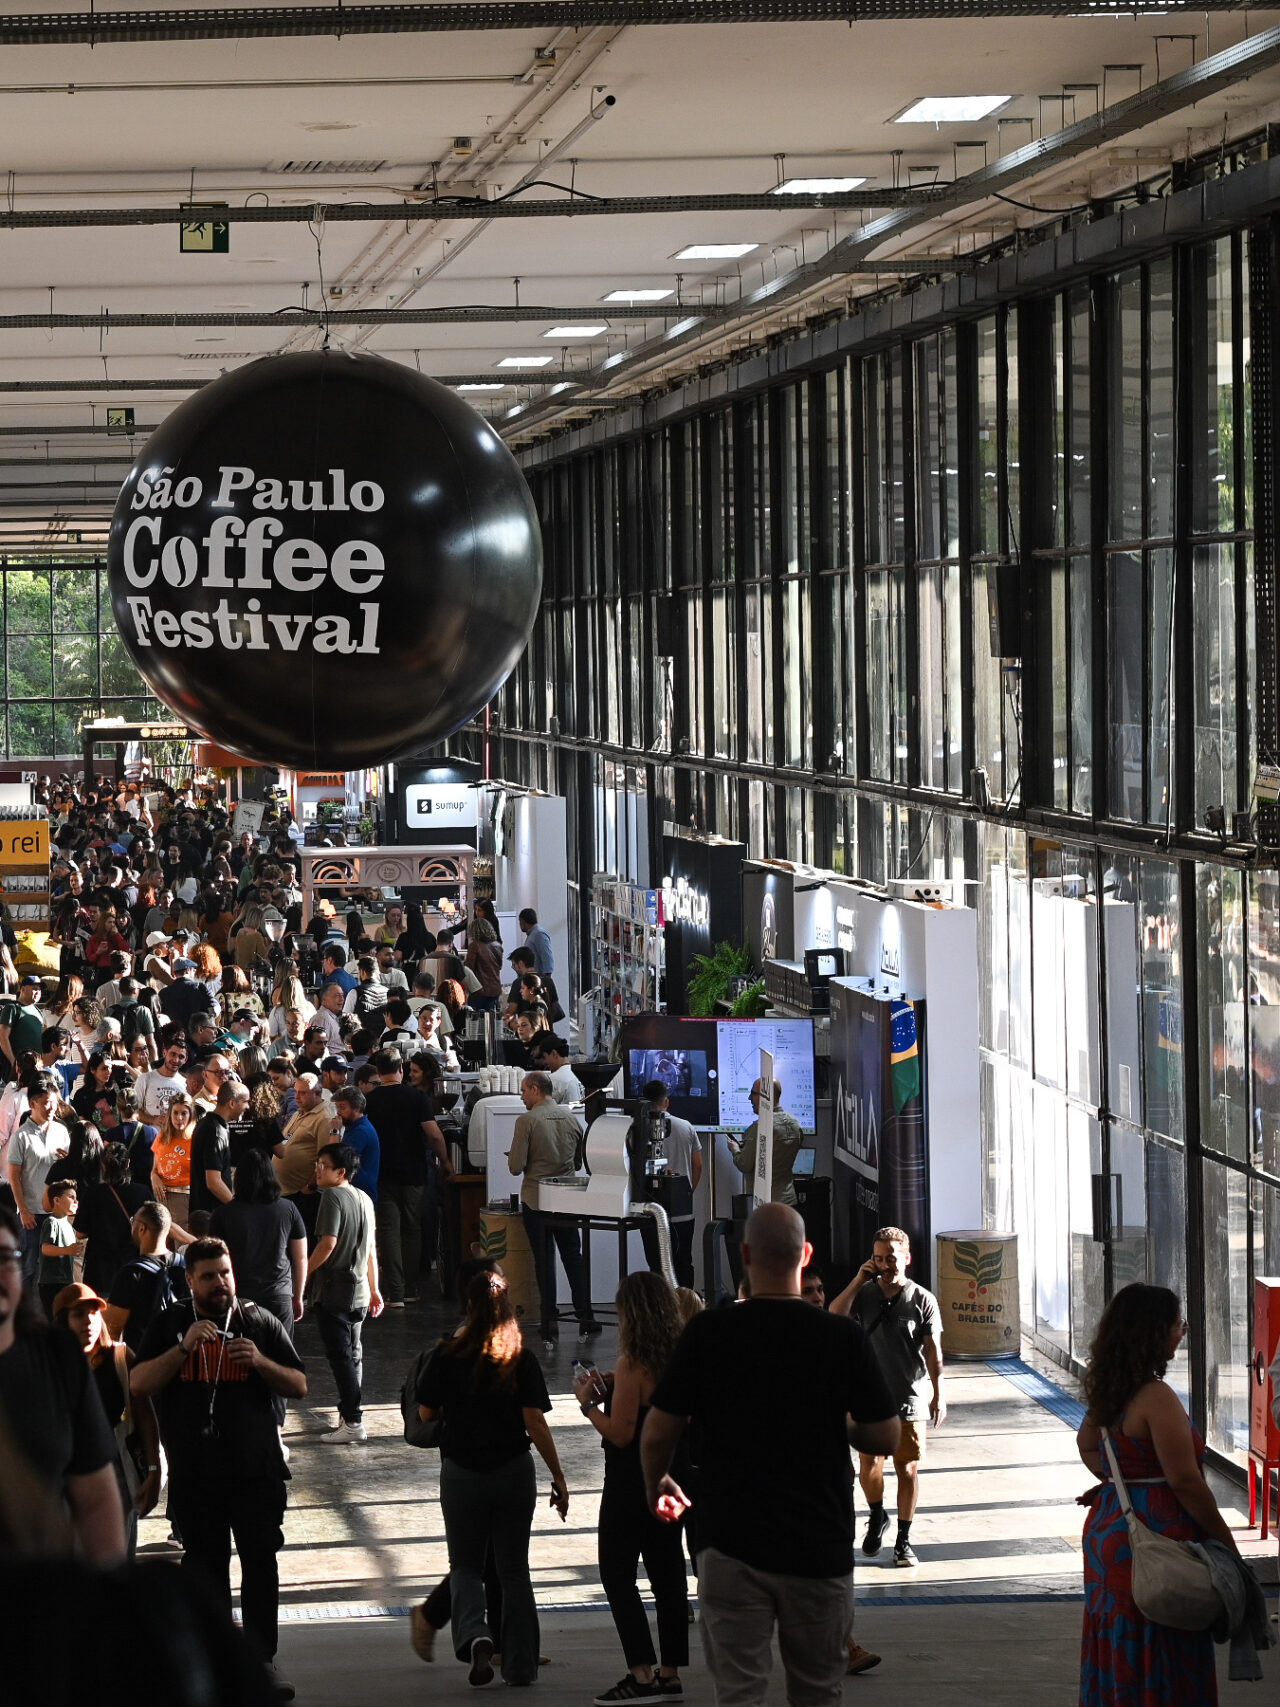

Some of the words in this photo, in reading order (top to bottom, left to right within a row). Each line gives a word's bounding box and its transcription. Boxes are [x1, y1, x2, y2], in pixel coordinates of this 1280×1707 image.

[130, 467, 203, 510] São
[211, 466, 385, 512] Paulo
[123, 515, 385, 594] Coffee
[127, 596, 380, 654] Festival
[435, 802, 465, 812] sumup
[11, 831, 40, 853] rei
[952, 1302, 985, 1312] CAFÉS
[988, 1304, 1003, 1312] DO
[958, 1314, 996, 1323] BRASIL
